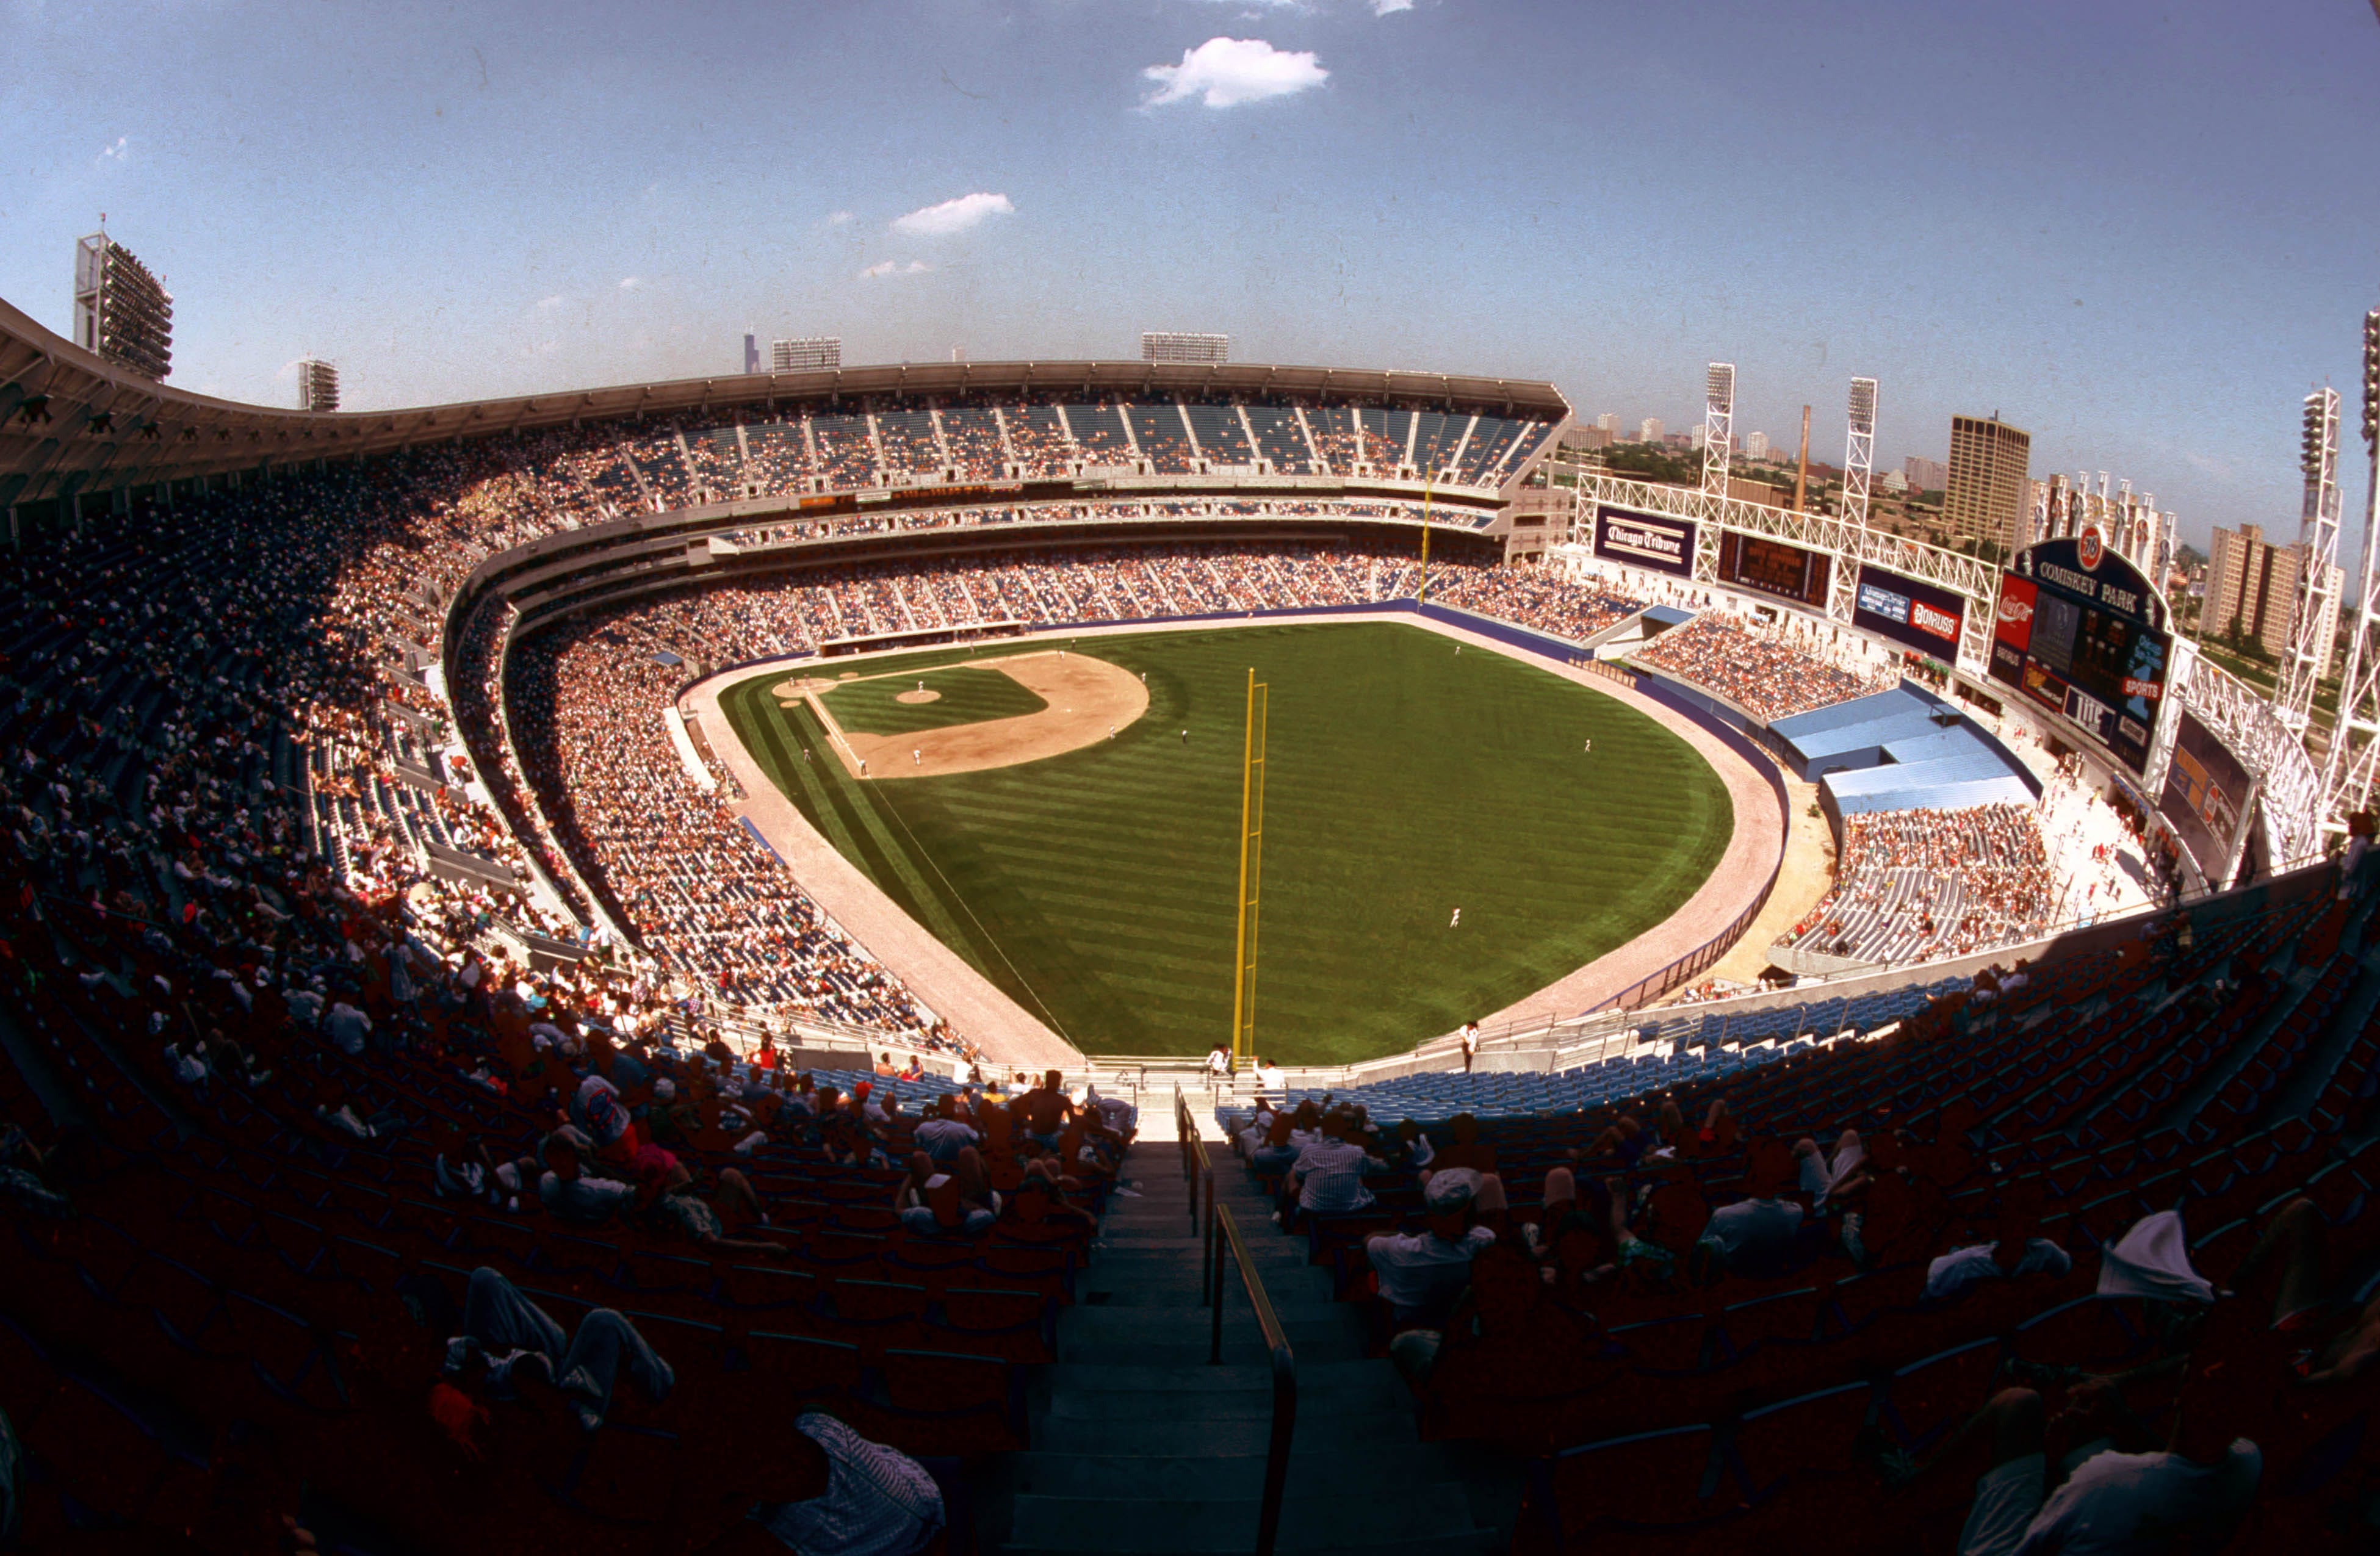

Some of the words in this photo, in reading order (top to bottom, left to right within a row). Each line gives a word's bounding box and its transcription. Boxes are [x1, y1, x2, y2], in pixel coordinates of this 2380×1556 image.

[1608, 526, 1643, 546] Chicago
[1644, 531, 1681, 553] Tribune
[2083, 535, 2097, 558] 76
[2039, 562, 2097, 597] COMISKEY
[2101, 583, 2138, 613] PARK
[1914, 603, 1954, 635] DONRUSS
[2126, 680, 2158, 699] SPORTS
